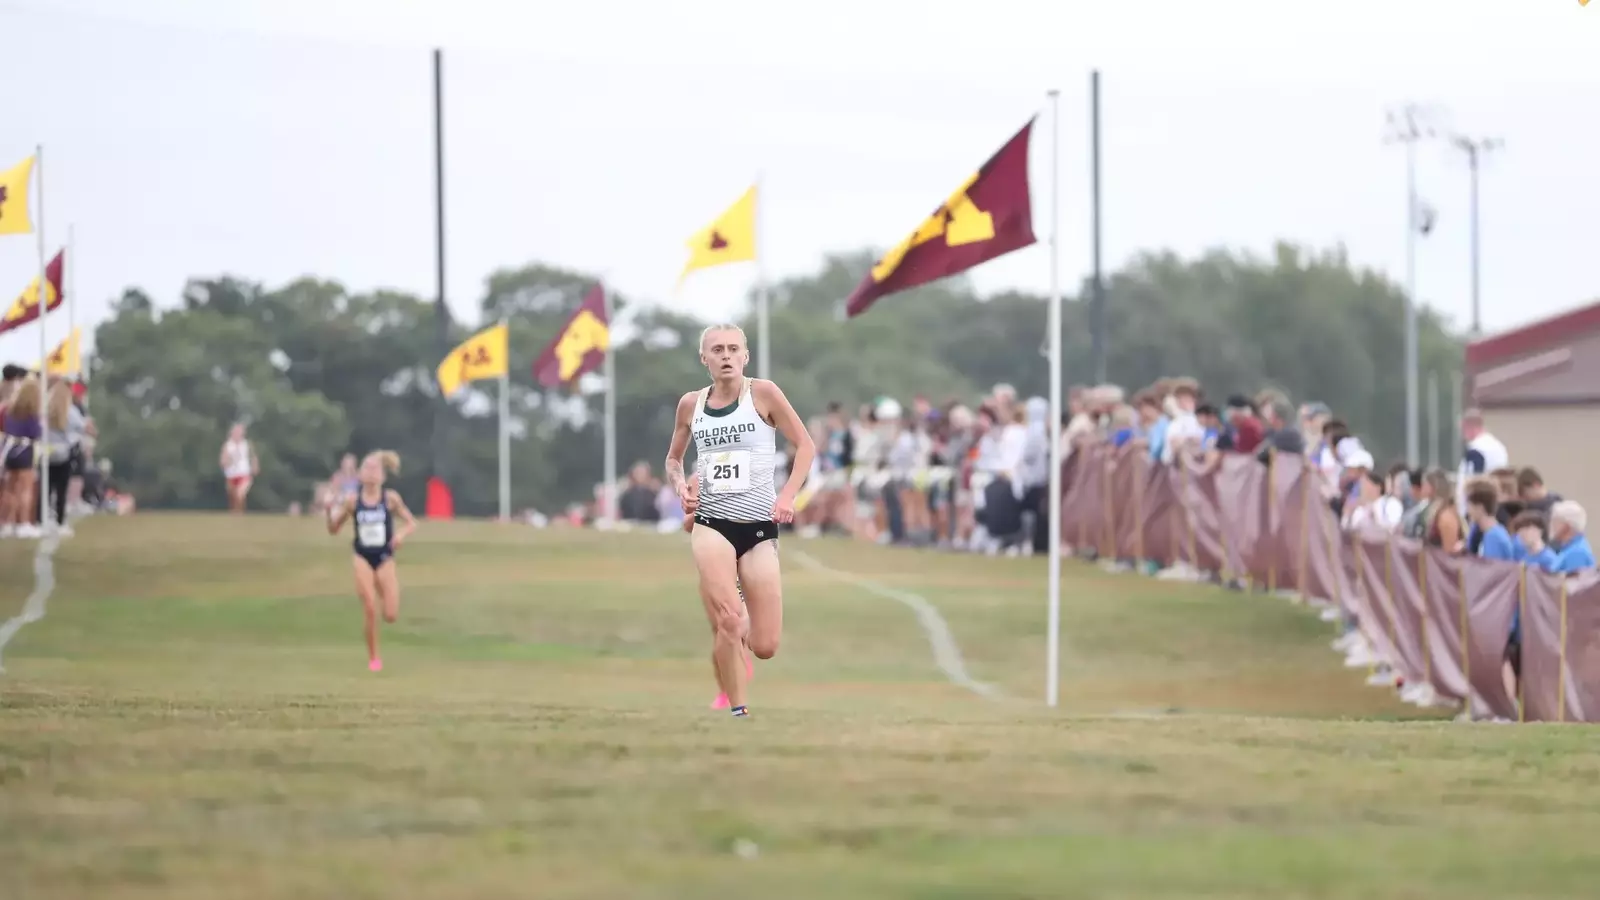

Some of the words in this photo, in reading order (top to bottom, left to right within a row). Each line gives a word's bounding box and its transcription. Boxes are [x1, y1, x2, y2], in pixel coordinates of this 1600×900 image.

[694, 423, 755, 440] COLORADO
[704, 434, 741, 447] STATE
[713, 464, 739, 480] 251
